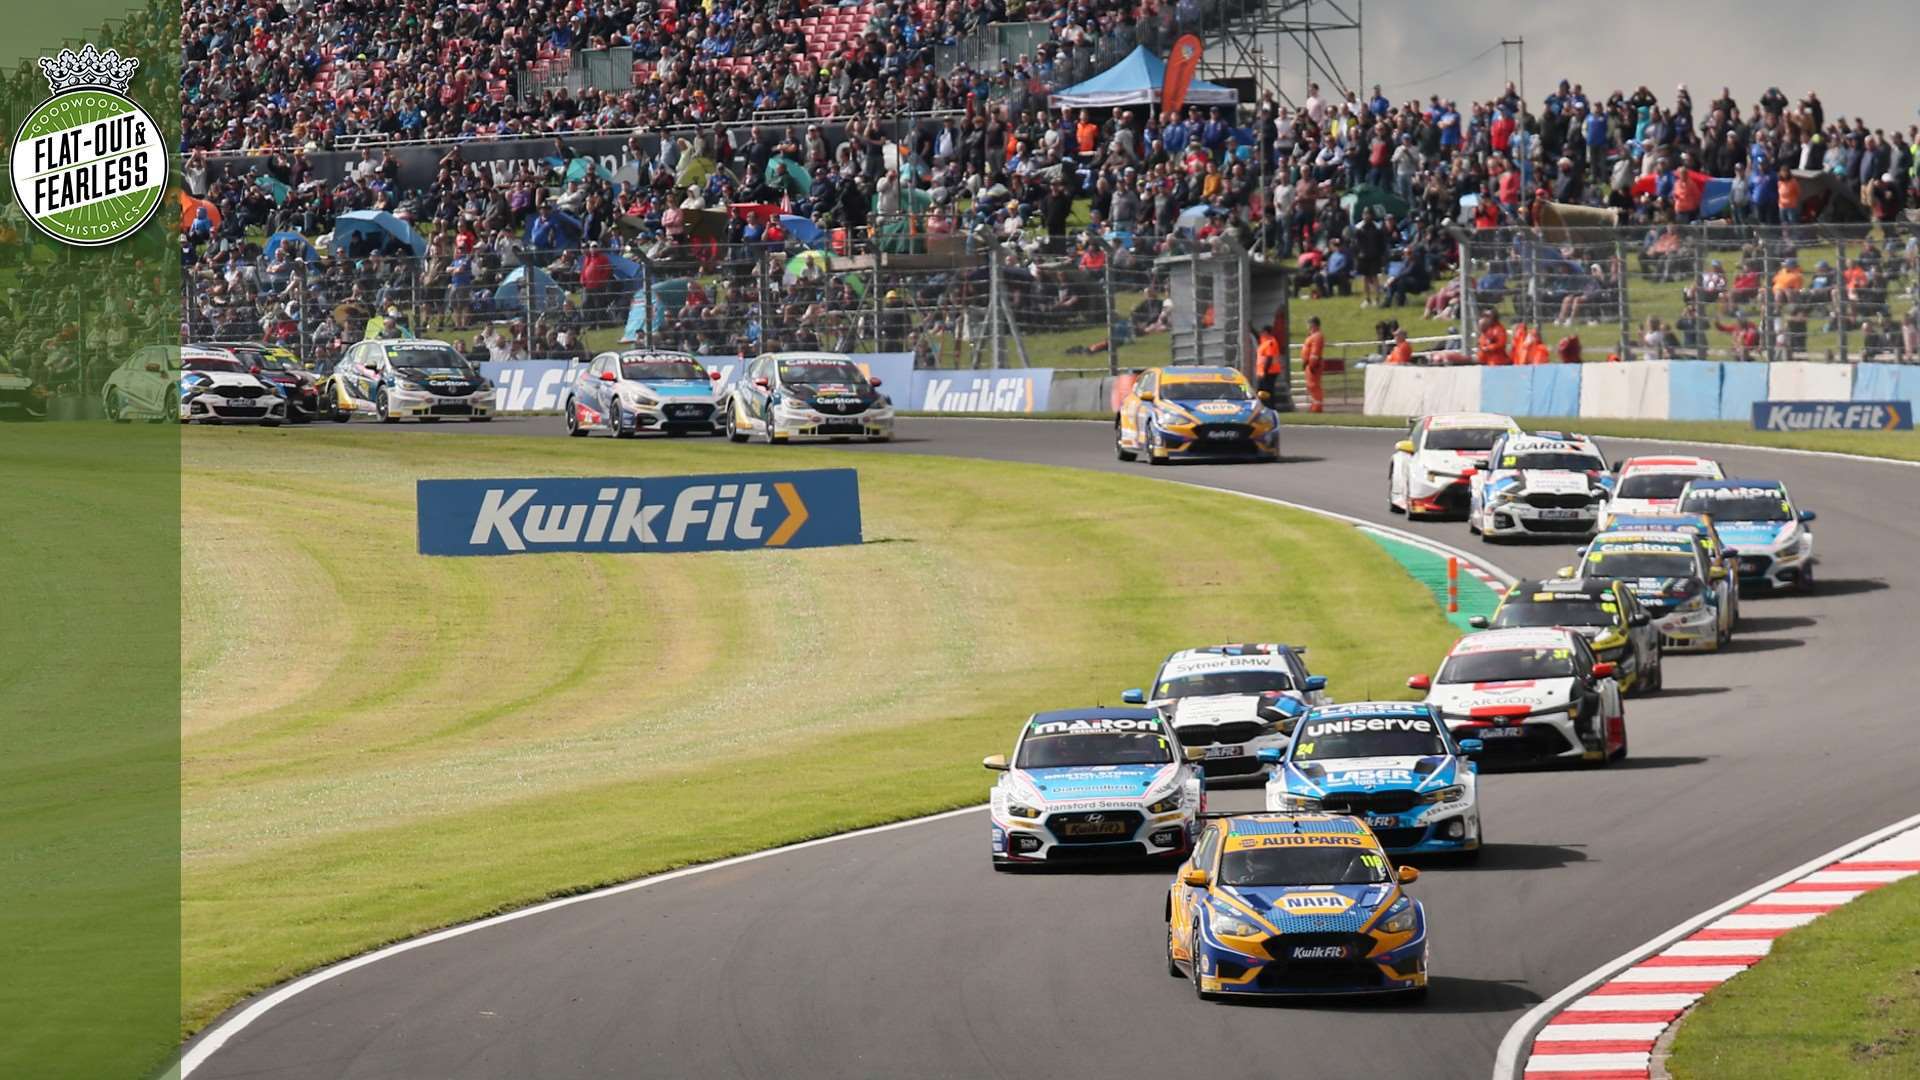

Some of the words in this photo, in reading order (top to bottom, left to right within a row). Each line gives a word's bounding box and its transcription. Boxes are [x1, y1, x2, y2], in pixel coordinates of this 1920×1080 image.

[1176, 661, 1225, 673] Sytner
[1230, 658, 1271, 667] BMW
[1295, 743, 1315, 755] 24
[1044, 803, 1096, 812] Hansford
[1099, 801, 1144, 809] Sensors
[1263, 837, 1305, 846] AUTO
[1309, 836, 1361, 845] PARTS
[1287, 897, 1342, 907] NAPA
